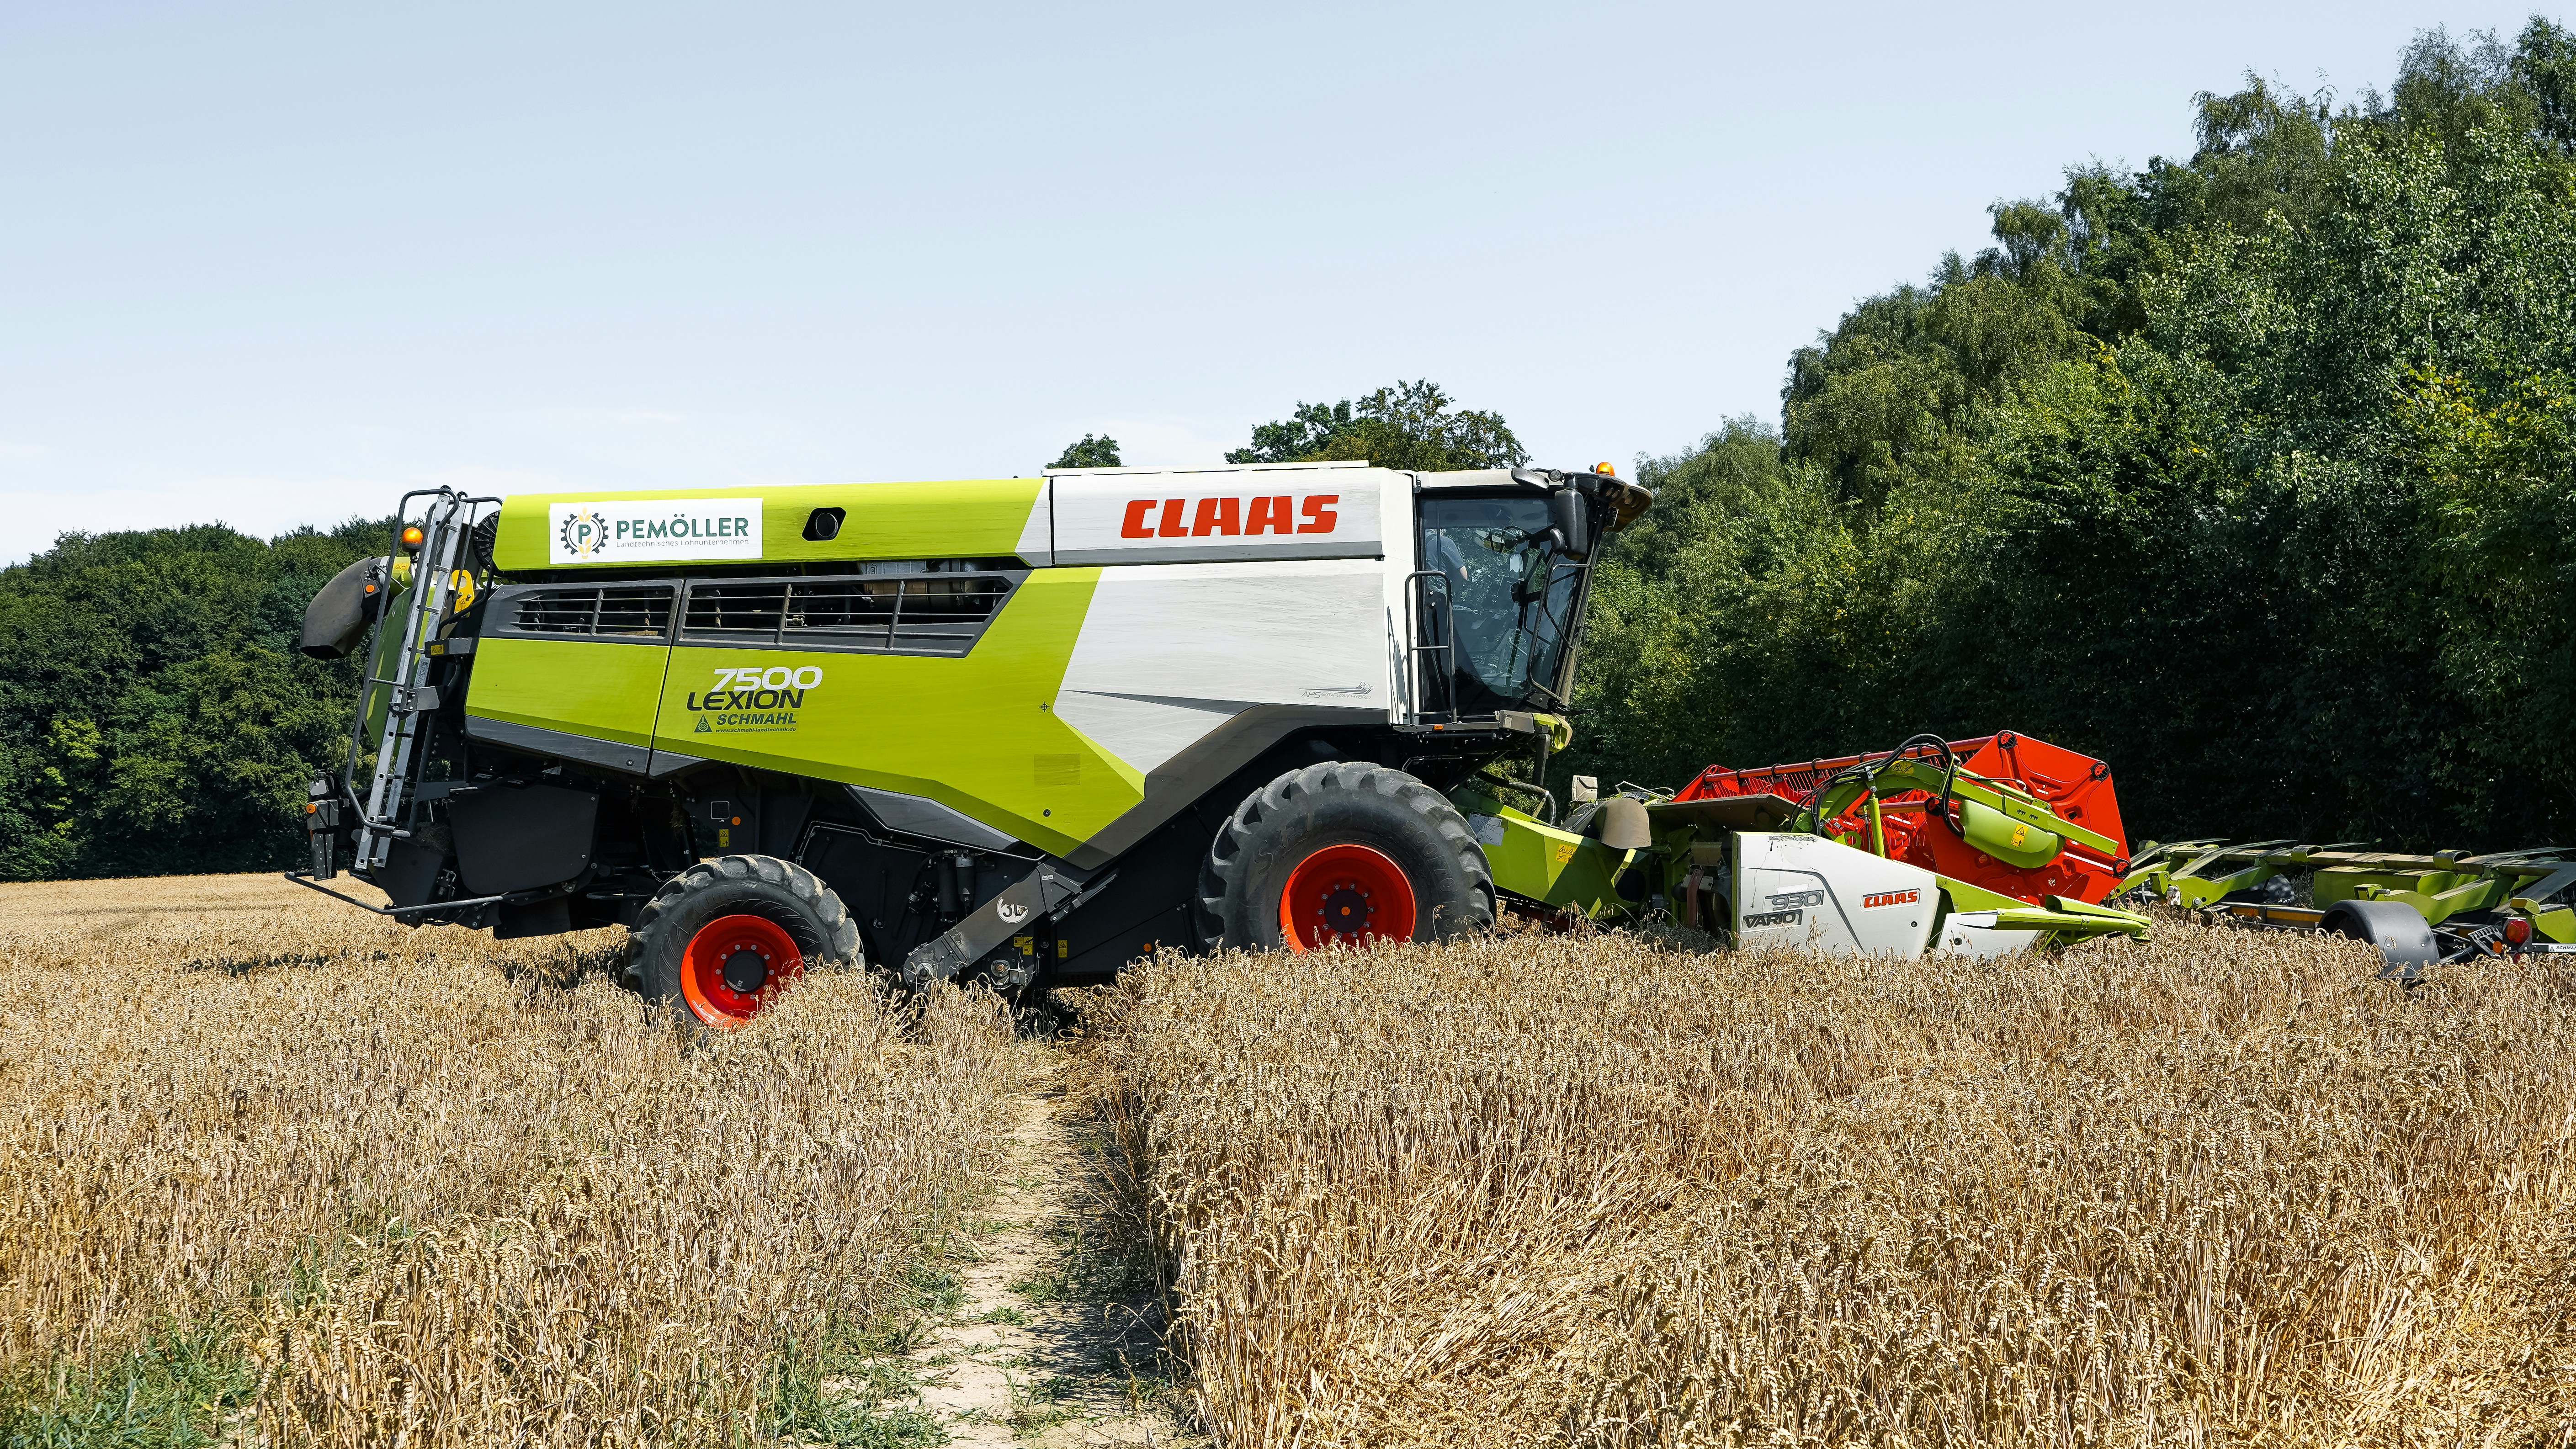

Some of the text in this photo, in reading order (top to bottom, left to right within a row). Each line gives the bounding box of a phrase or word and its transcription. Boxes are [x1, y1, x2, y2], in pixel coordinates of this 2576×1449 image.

[616, 514, 749, 539] PEMÖLLER
[1121, 495, 1339, 539] CLAAS
[578, 524, 591, 545] P
[710, 666, 823, 692] 7500
[686, 689, 805, 711] LEXION
[716, 713, 797, 726] SCHMAHL
[1772, 891, 1822, 911] 930
[1864, 891, 1918, 908] CLAAS
[1744, 912, 1796, 929] VARIO
